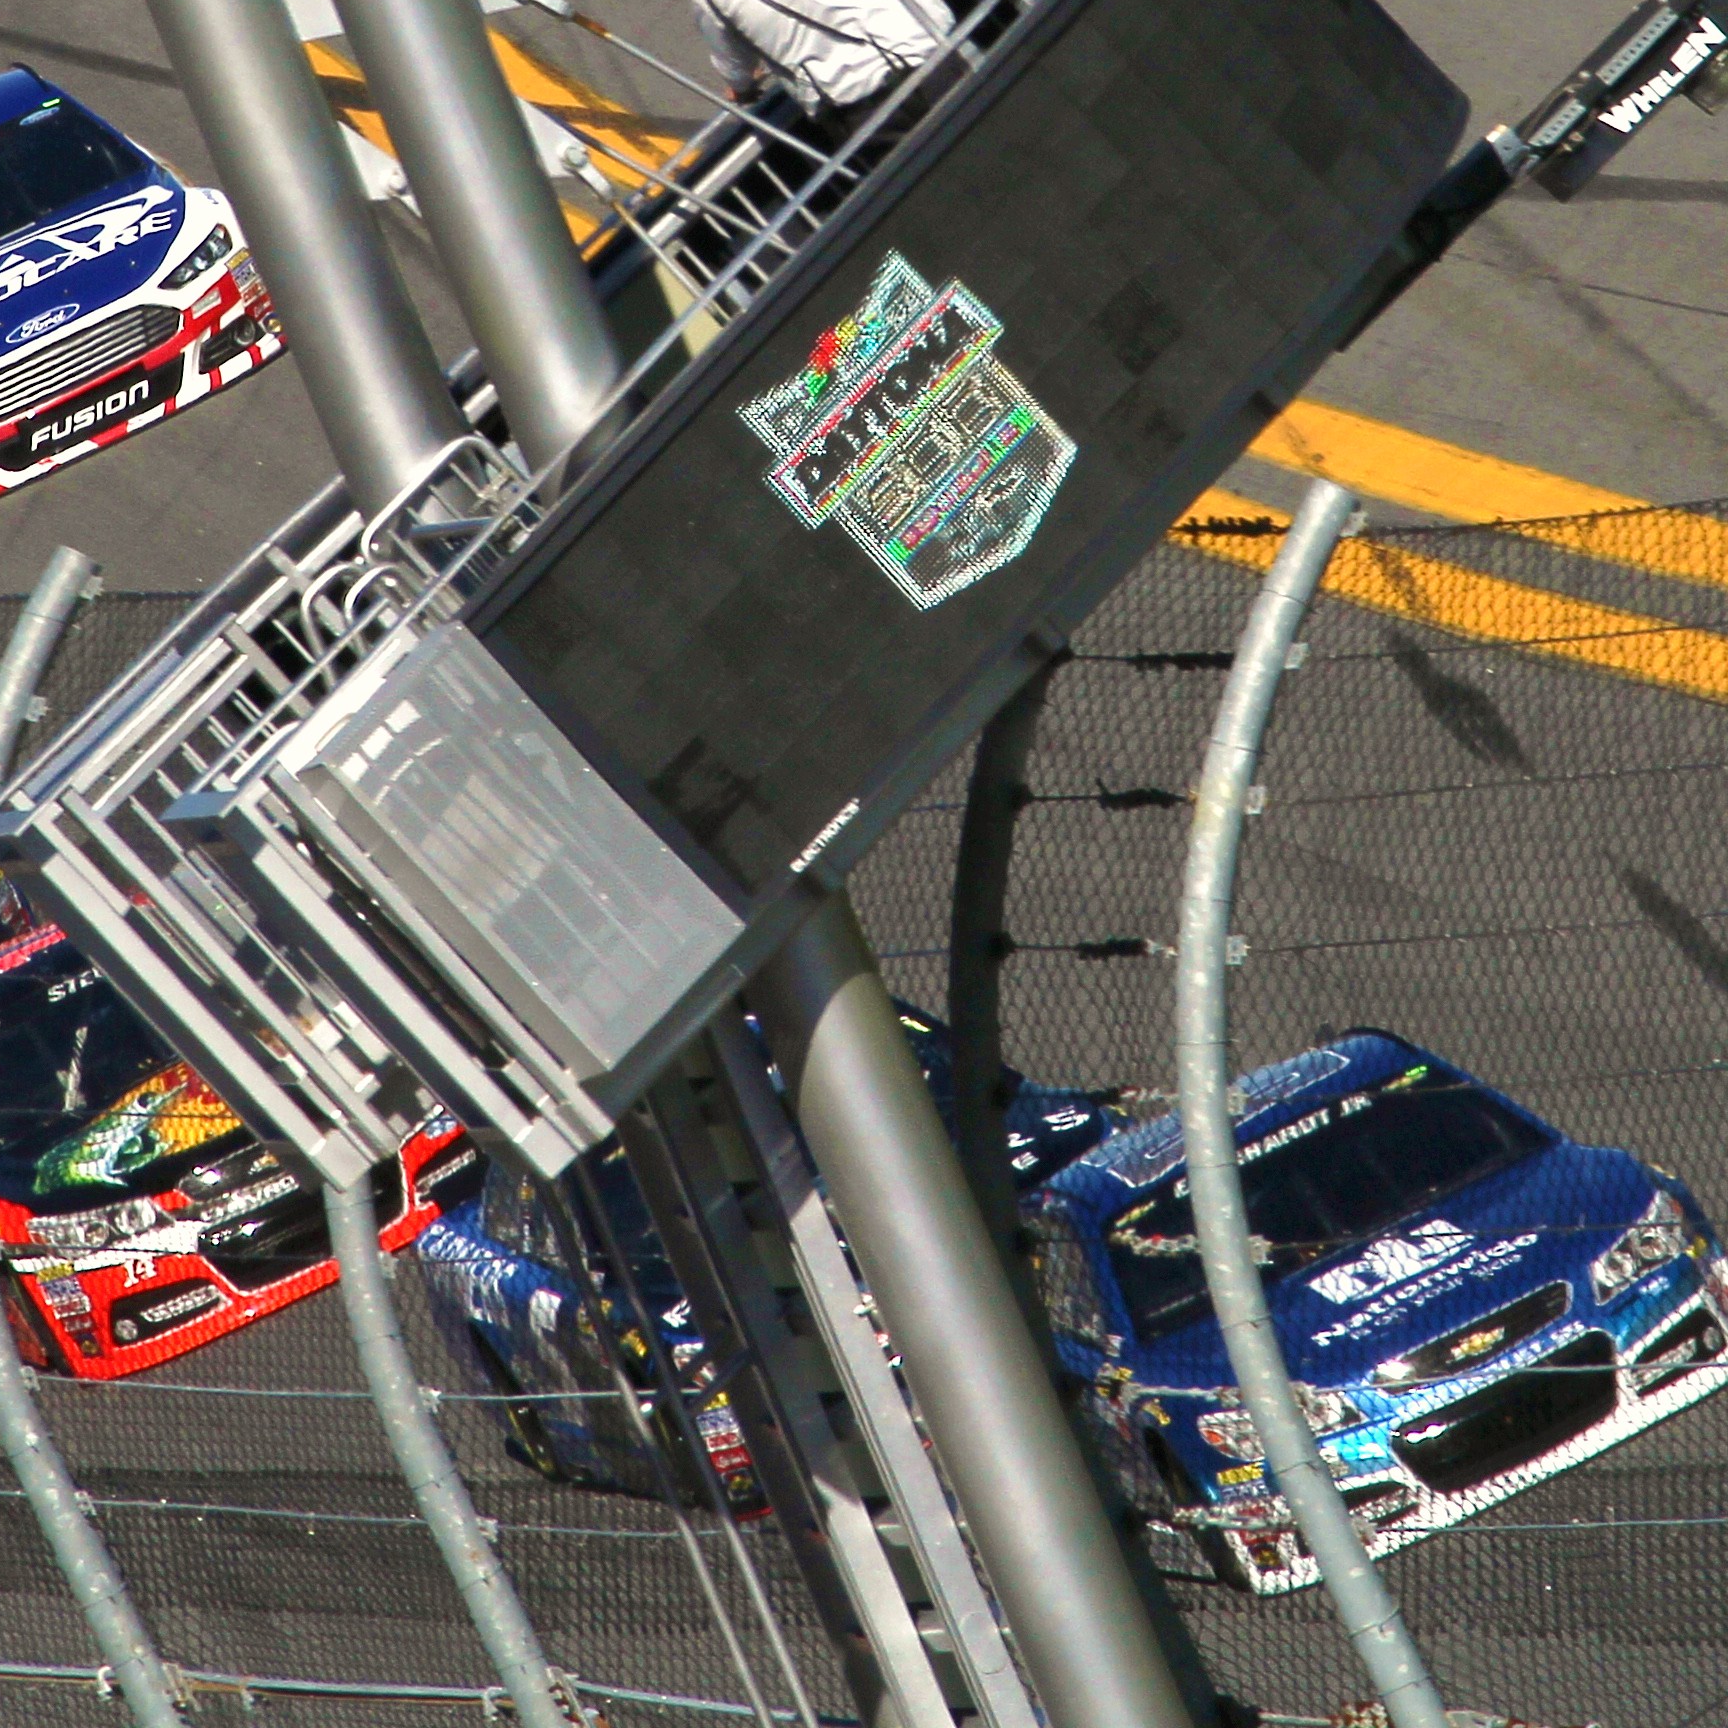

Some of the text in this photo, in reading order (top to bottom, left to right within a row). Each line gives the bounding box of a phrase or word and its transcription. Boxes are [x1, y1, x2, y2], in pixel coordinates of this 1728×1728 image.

[1597, 16, 1727, 134] WHELEN
[30, 379, 150, 452] FUSION
[786, 304, 983, 503] DAYTONA
[123, 1256, 158, 1288] 14
[1310, 1233, 1539, 1348] Nationwide
